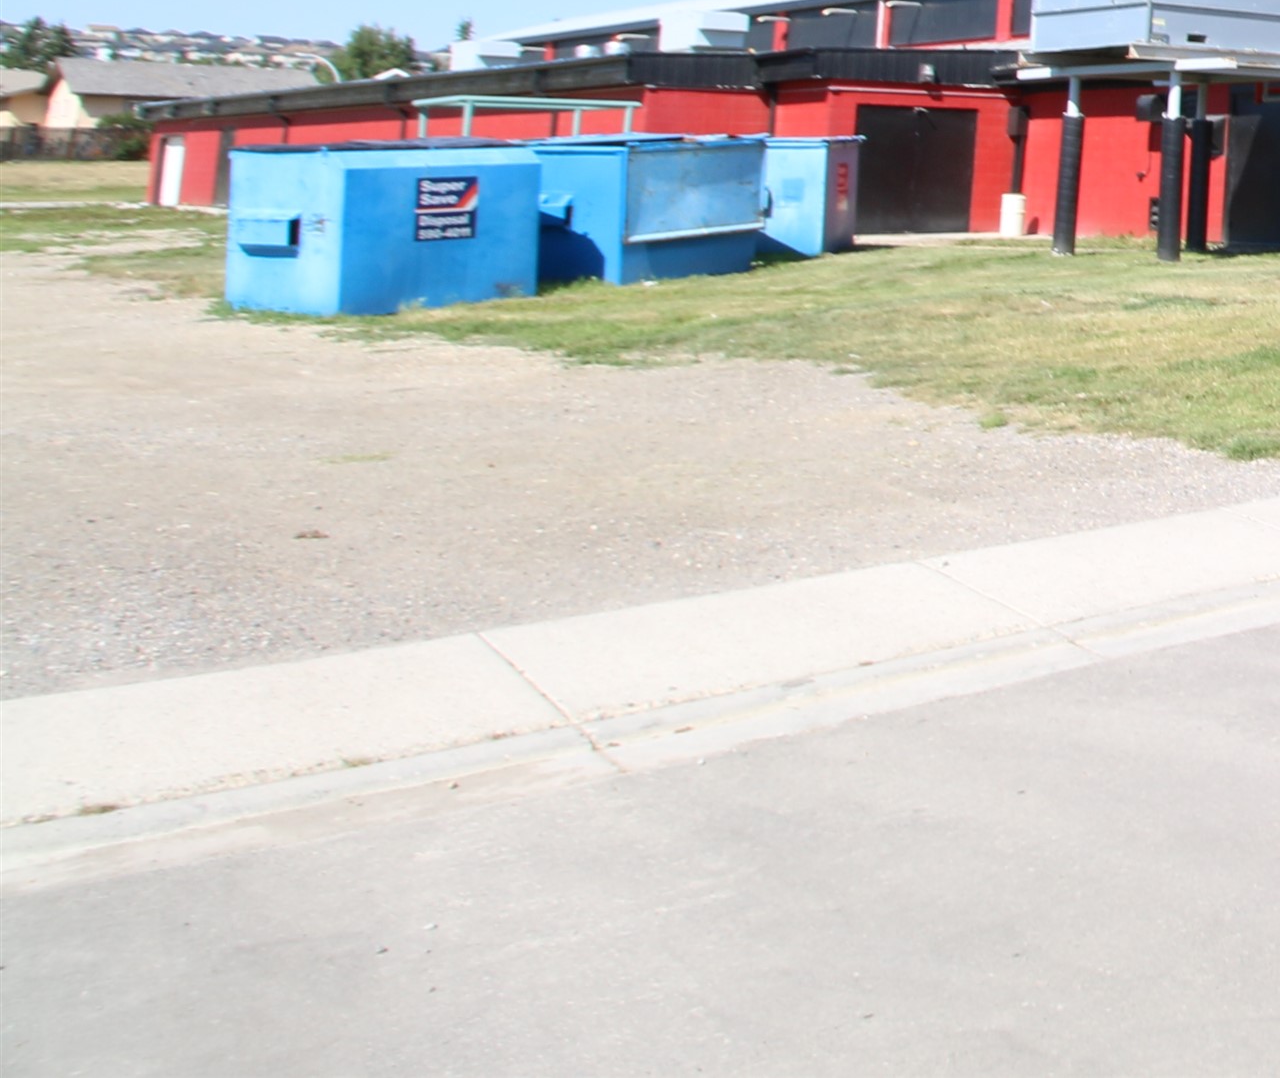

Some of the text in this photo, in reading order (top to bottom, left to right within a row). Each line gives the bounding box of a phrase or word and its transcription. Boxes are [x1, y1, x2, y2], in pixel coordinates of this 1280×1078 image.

[420, 180, 466, 193] Super
[420, 193, 459, 205] Save
[419, 213, 469, 227] Disposal
